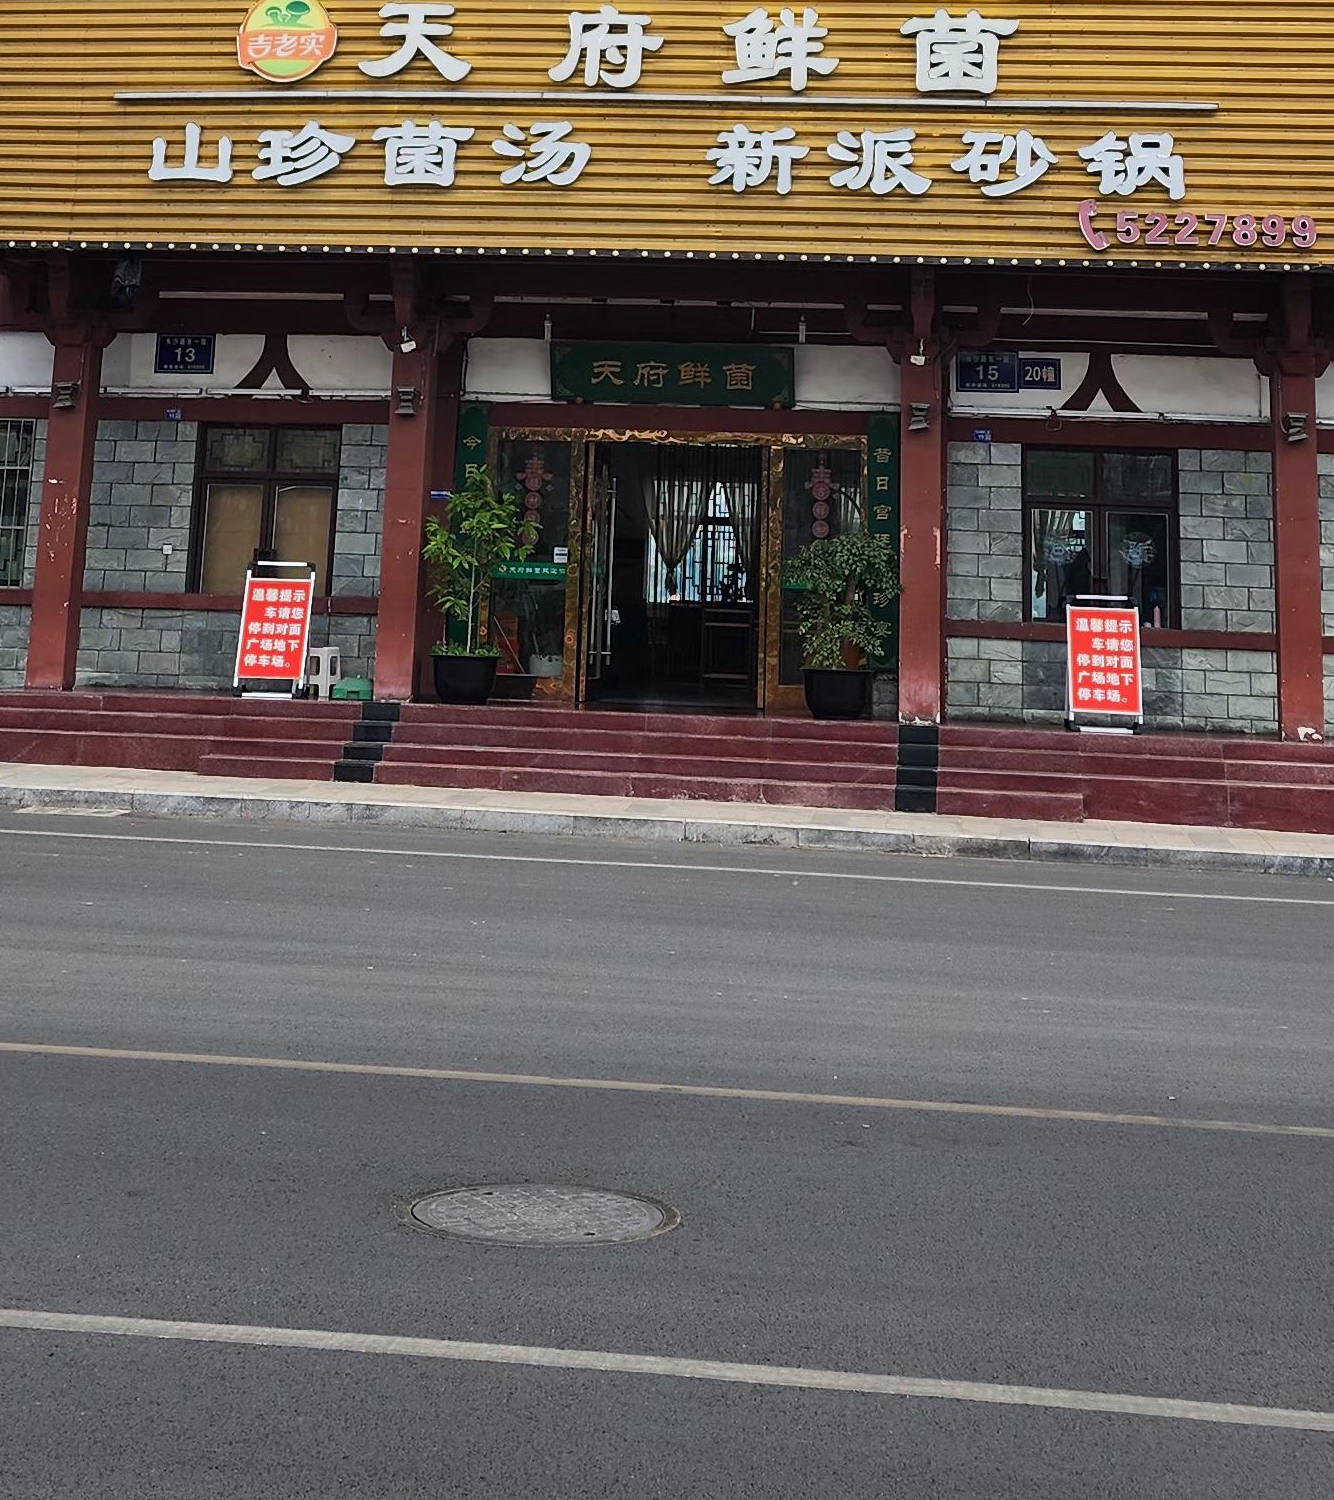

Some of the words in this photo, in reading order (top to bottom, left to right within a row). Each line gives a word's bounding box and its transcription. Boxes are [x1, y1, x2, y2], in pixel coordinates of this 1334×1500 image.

[357, 1, 1020, 95] 天府鲜菌
[147, 118, 593, 188] 山珍菌汤
[704, 122, 1187, 201] 新派砂锅
[1114, 210, 1318, 250] 5227899
[174, 347, 196, 362] 13
[590, 360, 757, 391] 天府鲜菌
[975, 365, 999, 381] 15
[251, 588, 305, 602] 温馨提示
[264, 606, 304, 619] 车请您
[248, 621, 302, 635] 停到对面
[1076, 617, 1133, 633] 温馨提示
[246, 638, 300, 652] 广场地下
[1091, 637, 1134, 652] 车请您
[244, 653, 291, 668] 停车场。
[1076, 653, 1134, 669] 停到对面
[1077, 670, 1134, 686] 广场地下
[1077, 687, 1128, 703] 停车场。
